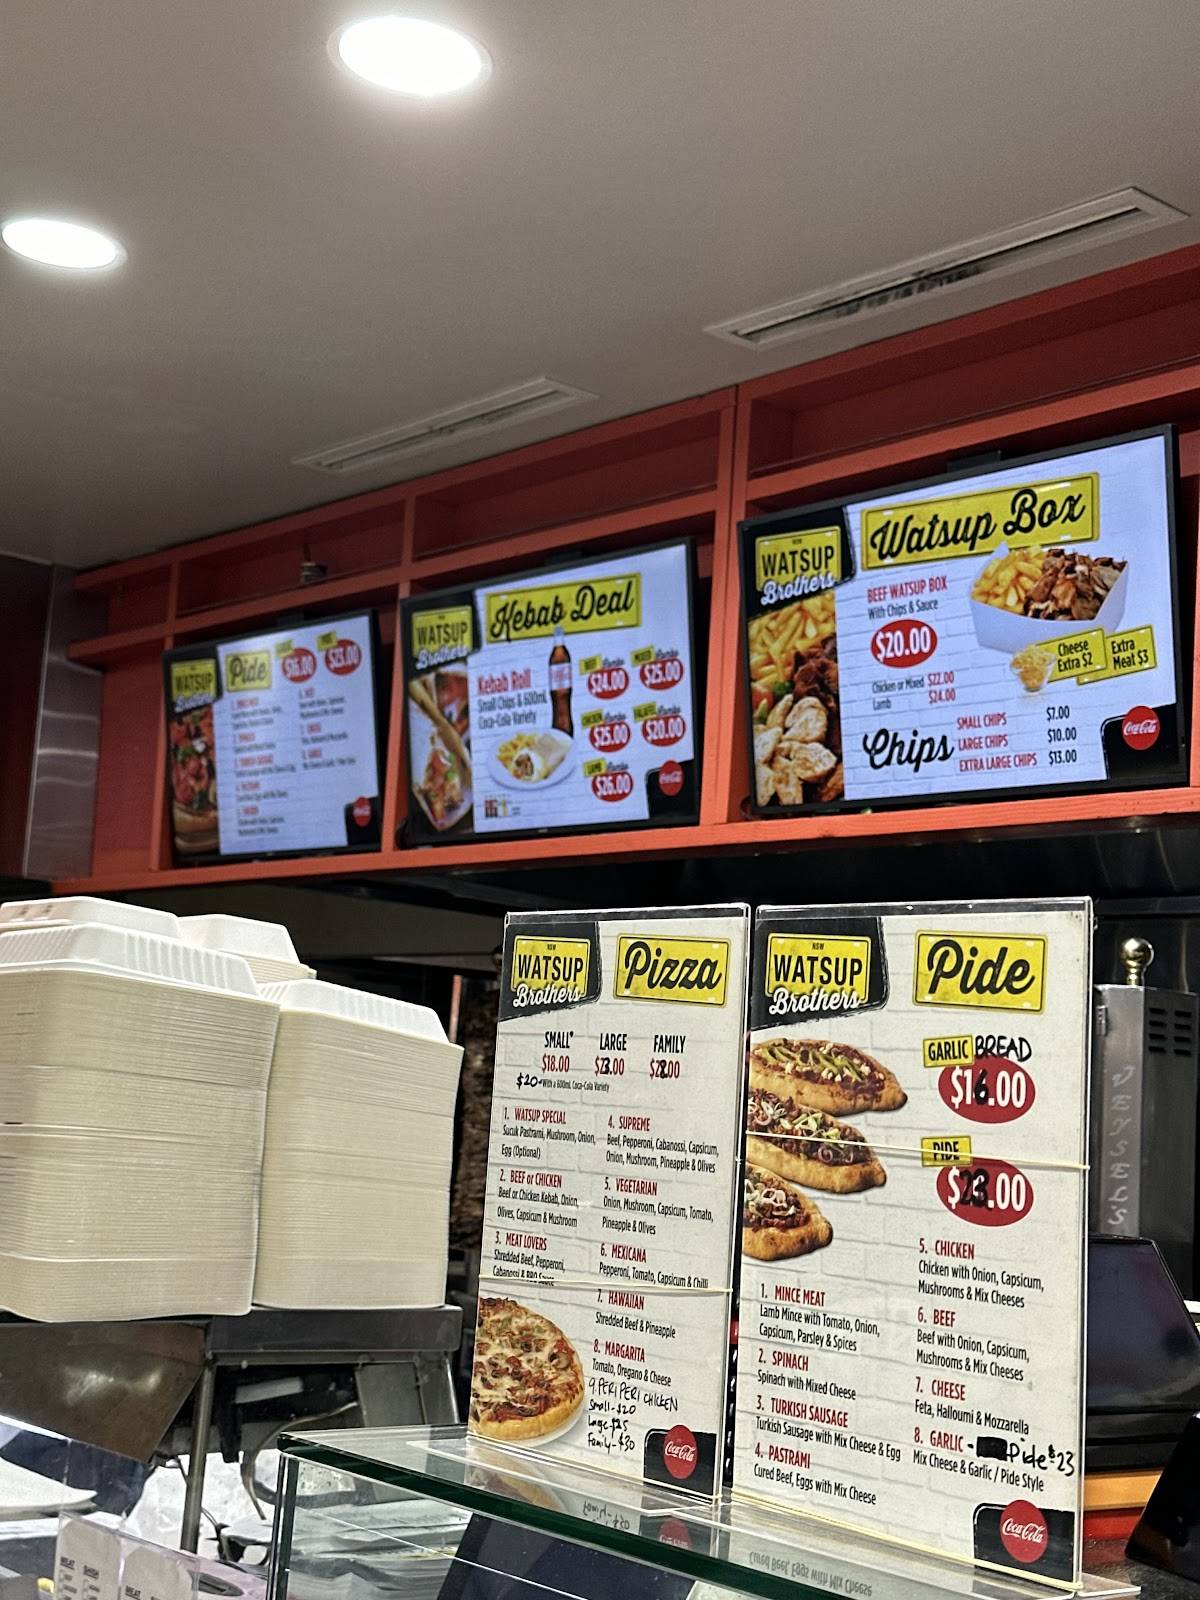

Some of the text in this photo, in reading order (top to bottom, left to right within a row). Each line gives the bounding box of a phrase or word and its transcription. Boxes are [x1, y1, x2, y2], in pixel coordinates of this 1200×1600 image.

[870, 488, 1086, 560] Watsup Box
[762, 546, 834, 577] WATSUP
[760, 572, 835, 606] Brothers
[867, 576, 947, 603] BEEF WATSUP BOX
[491, 580, 634, 642] Kebab Deal
[868, 600, 938, 620] With Chips & Sauce
[416, 622, 468, 645] WATSUP
[876, 626, 930, 662] $20.00
[1058, 640, 1089, 656] Cheese
[1111, 639, 1135, 654] Extra
[230, 655, 266, 685] Pide
[1058, 652, 1093, 672] Extra $2
[1113, 649, 1148, 670] Meat $3
[872, 680, 896, 694] Chicken
[905, 677, 924, 689] Mixed
[928, 671, 954, 686] $22.00
[873, 698, 891, 711] Lamb
[957, 706, 1069, 730] SMALL CHIPS $7.00
[863, 728, 954, 773] Chips
[959, 728, 1077, 751] LARGE CHIPS $10.00
[960, 750, 1077, 772] EXTRA LARGE CHIPS $13.00
[518, 954, 583, 982] WATSUP
[624, 941, 722, 989] Pizza
[774, 954, 862, 986] WATSUP
[927, 939, 1035, 995] Pide
[513, 983, 580, 1008] Brothers
[769, 988, 861, 1016] Brothers
[600, 1034, 627, 1050] LARGE
[654, 1035, 686, 1054] FAMILY
[929, 1040, 968, 1061] GARLIC
[974, 1035, 1032, 1062] BREAD
[542, 1053, 570, 1074] $18.00
[951, 1066, 1026, 1109] $16.00
[515, 1108, 566, 1124] WATSUP SPECIAL
[619, 1116, 650, 1132] SUPREME
[510, 1171, 562, 1188] BEEF or CHICKEN
[615, 1178, 658, 1196] VEGETARIAN
[506, 1232, 547, 1251] MEAT LOVERS
[612, 1244, 647, 1263] MEXICANA
[935, 1240, 975, 1260] CHICKEN
[919, 1260, 1044, 1293] Chicken with Onion, Capsicum,
[609, 1291, 644, 1310] HAWAIIAN
[775, 1286, 825, 1307] MINCE MEAT
[918, 1280, 1025, 1308] Mushrooms & Mix Cheeses
[760, 1304, 880, 1337] Lamb Mince with Tomato, Onion,
[933, 1309, 956, 1327] BEEF
[759, 1323, 857, 1352] Capsicum, Parsley & Spices
[917, 1329, 1029, 1363] Beef with Onion, Capsicum,
[605, 1341, 645, 1363] MARGARITA
[772, 1350, 809, 1372] SPINACH
[917, 1349, 1024, 1381] Mushrooms & Mix Cheeses
[599, 1377, 678, 1412] PERI PERI CHICKEN
[757, 1370, 856, 1400] Spinach with Mixed Cheese
[932, 1379, 966, 1401] CHEESE
[771, 1398, 848, 1428] TURKISH SAUSAGE
[915, 1400, 1029, 1435] Feta, Halloumi & Mozzarella
[756, 1416, 901, 1462] Turkish Sausage with Mix Cheese & Egg
[930, 1430, 964, 1452] GARLIC
[769, 1445, 811, 1469] PASTRAMI
[913, 1450, 1044, 1492] Mix Cheese & Garlic / Pide Style
[754, 1463, 876, 1505] Cured Beef, Eggs with Mix Cheese
